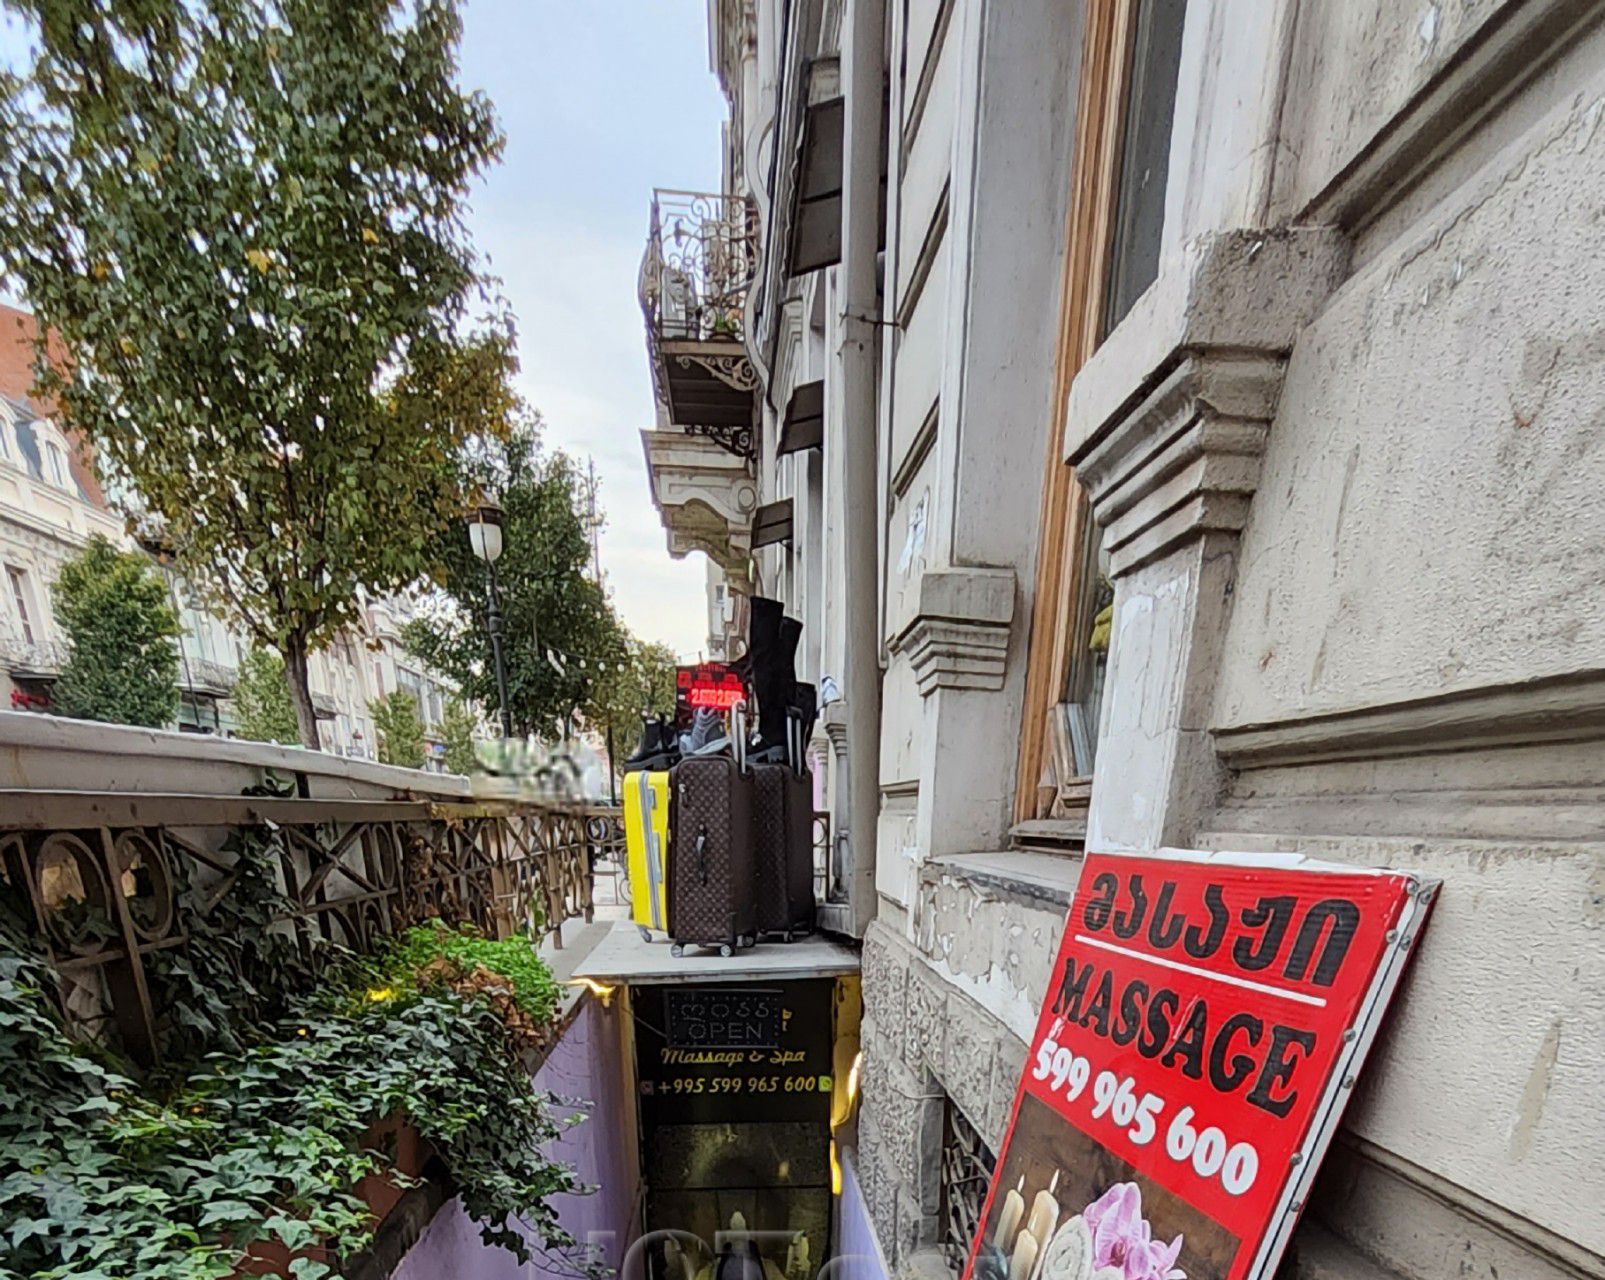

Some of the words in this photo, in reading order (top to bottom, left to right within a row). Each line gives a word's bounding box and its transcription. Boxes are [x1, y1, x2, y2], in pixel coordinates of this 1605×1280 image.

[1083, 872, 1361, 987] მასაჟი
[660, 1047, 745, 1067] Massage
[749, 1050, 765, 1062] &
[769, 1050, 806, 1066] Spa
[689, 1021, 762, 1039] OPEN
[1051, 957, 1317, 1118] MASSAGE
[658, 1078, 705, 1094] +995
[708, 1077, 742, 1093] 599
[748, 1076, 780, 1093] 965
[784, 1076, 816, 1092] 600
[1032, 1037, 1091, 1102] 599
[1092, 1070, 1165, 1146] 965
[1166, 1105, 1259, 1196] 600
